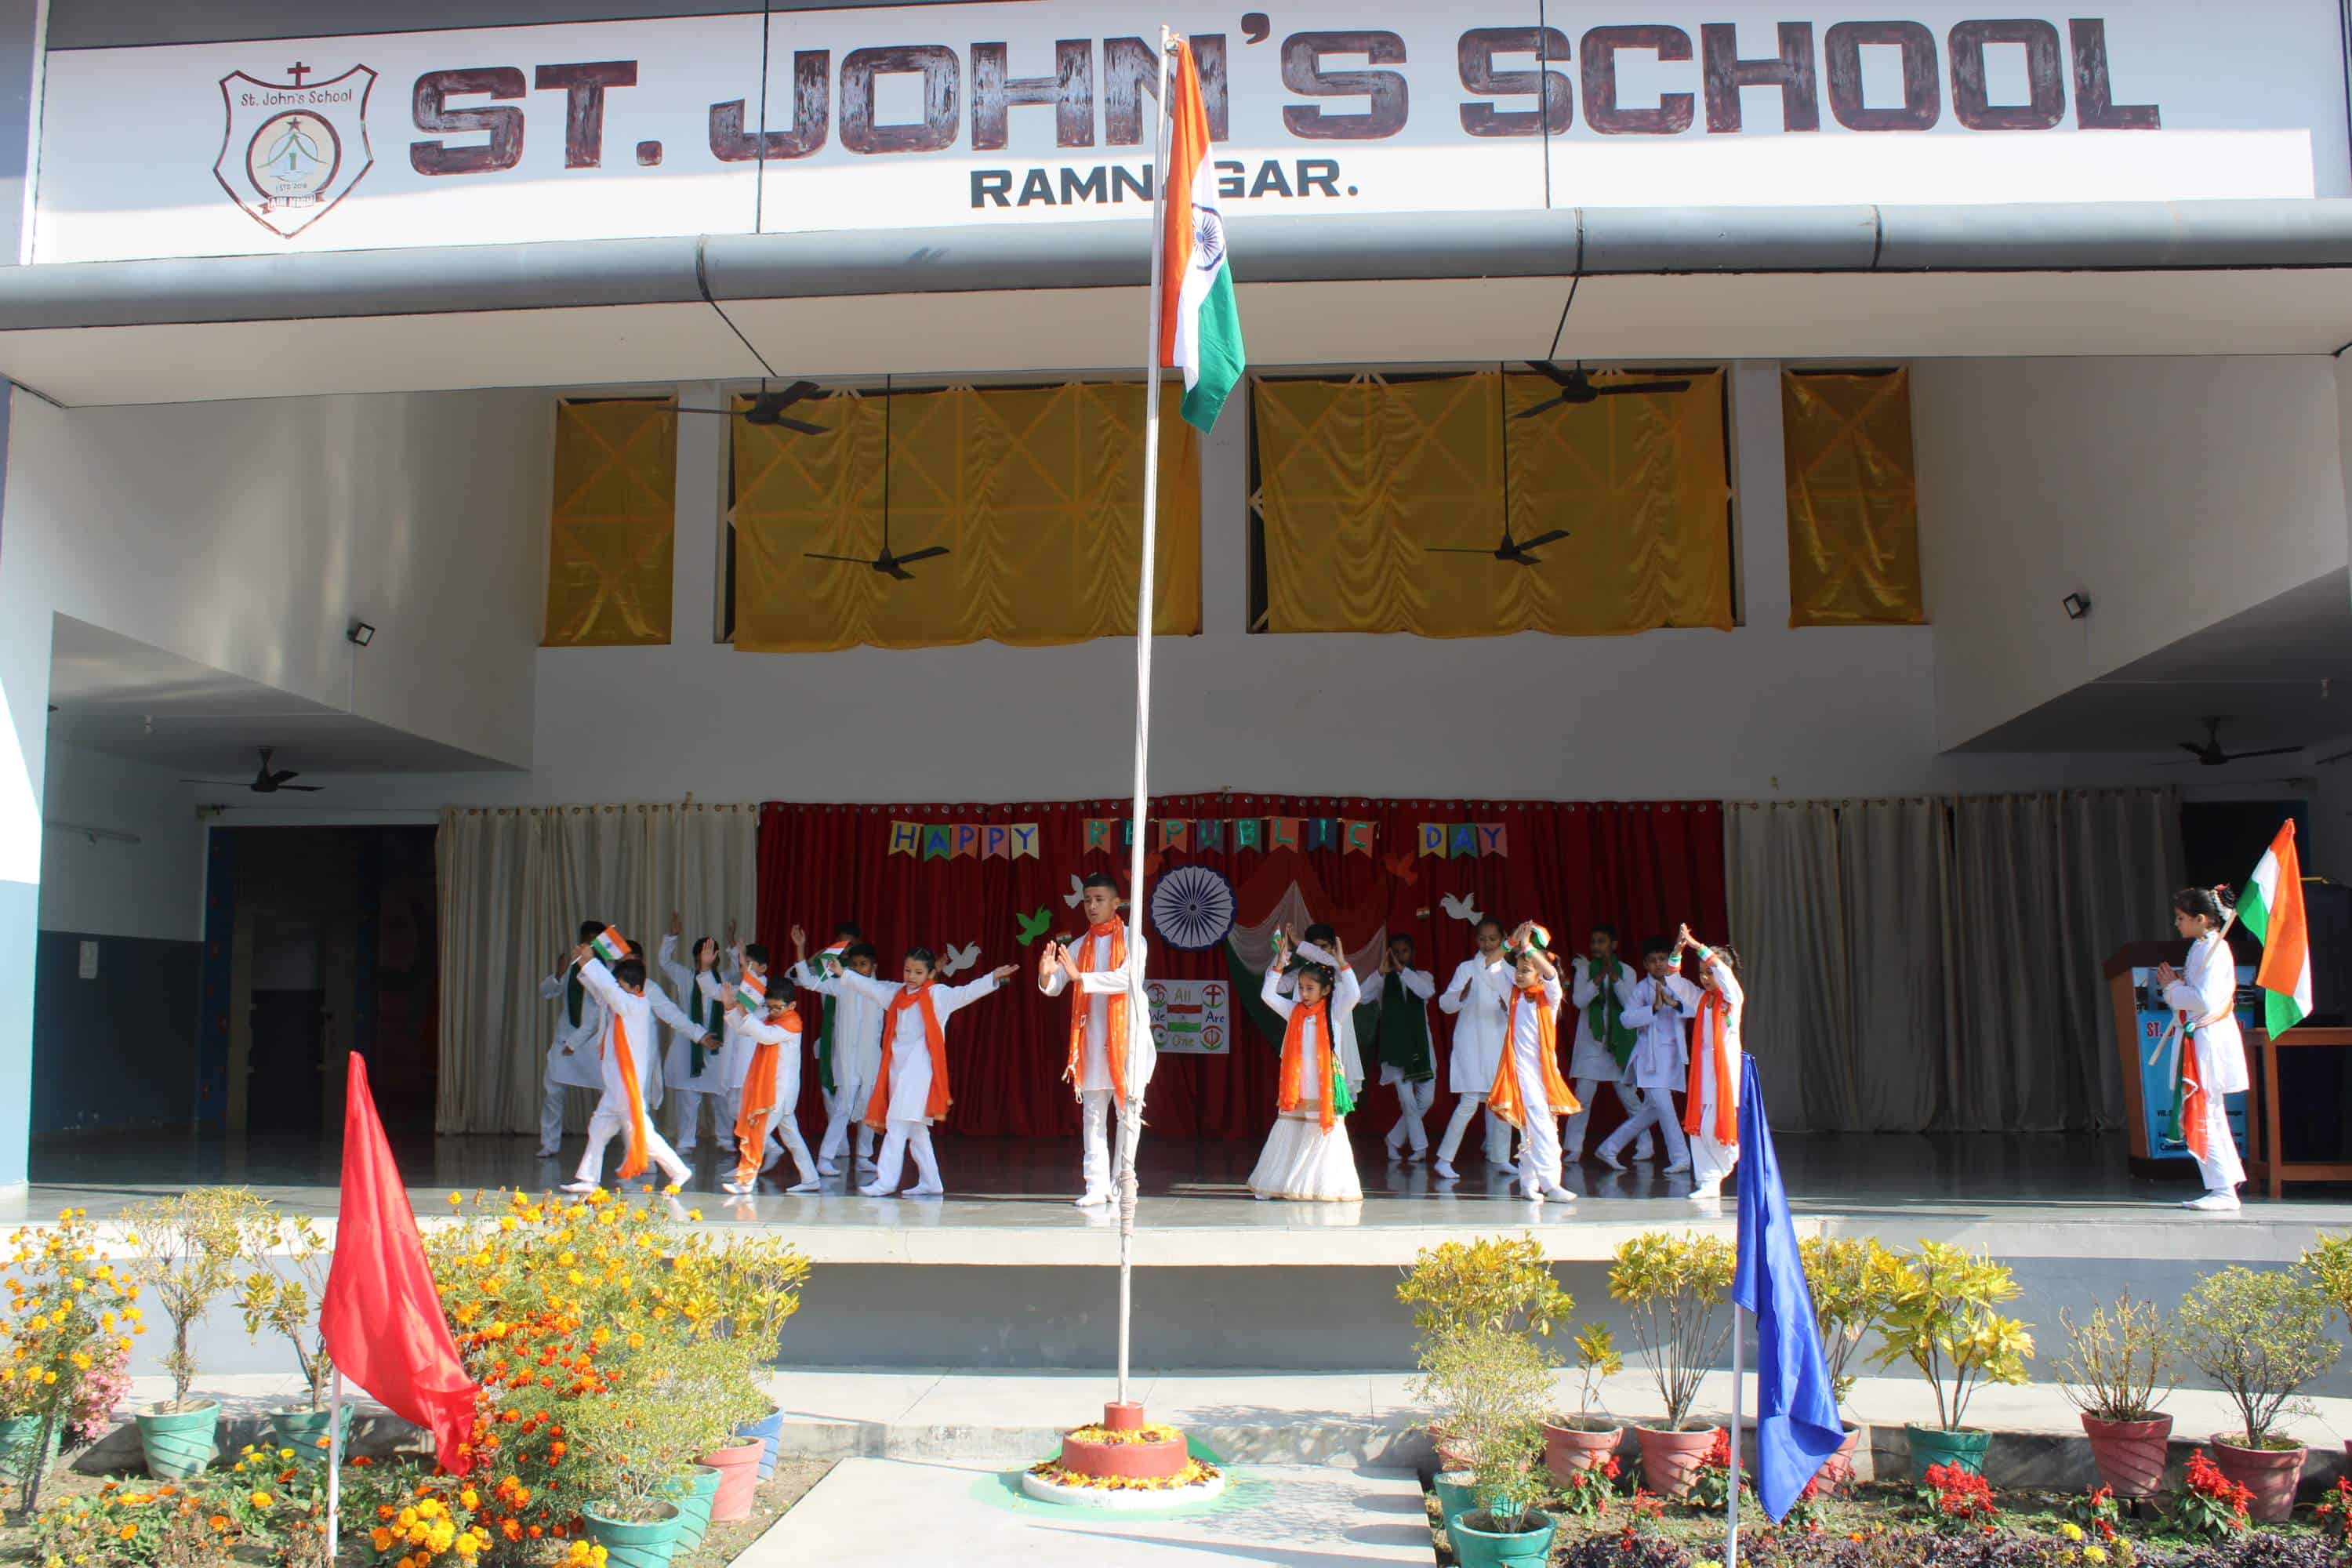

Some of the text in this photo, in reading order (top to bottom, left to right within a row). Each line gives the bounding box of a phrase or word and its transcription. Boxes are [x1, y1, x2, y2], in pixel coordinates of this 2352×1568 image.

[241, 88, 352, 107] St. John's School
[409, 13, 2161, 176] ST. JOHN'S SCHOOL
[971, 158, 1359, 209] RAMNGAR.
[894, 822, 1036, 855] HAPPY
[1425, 826, 1501, 850] DAY
[1205, 1010, 1225, 1023] Are
